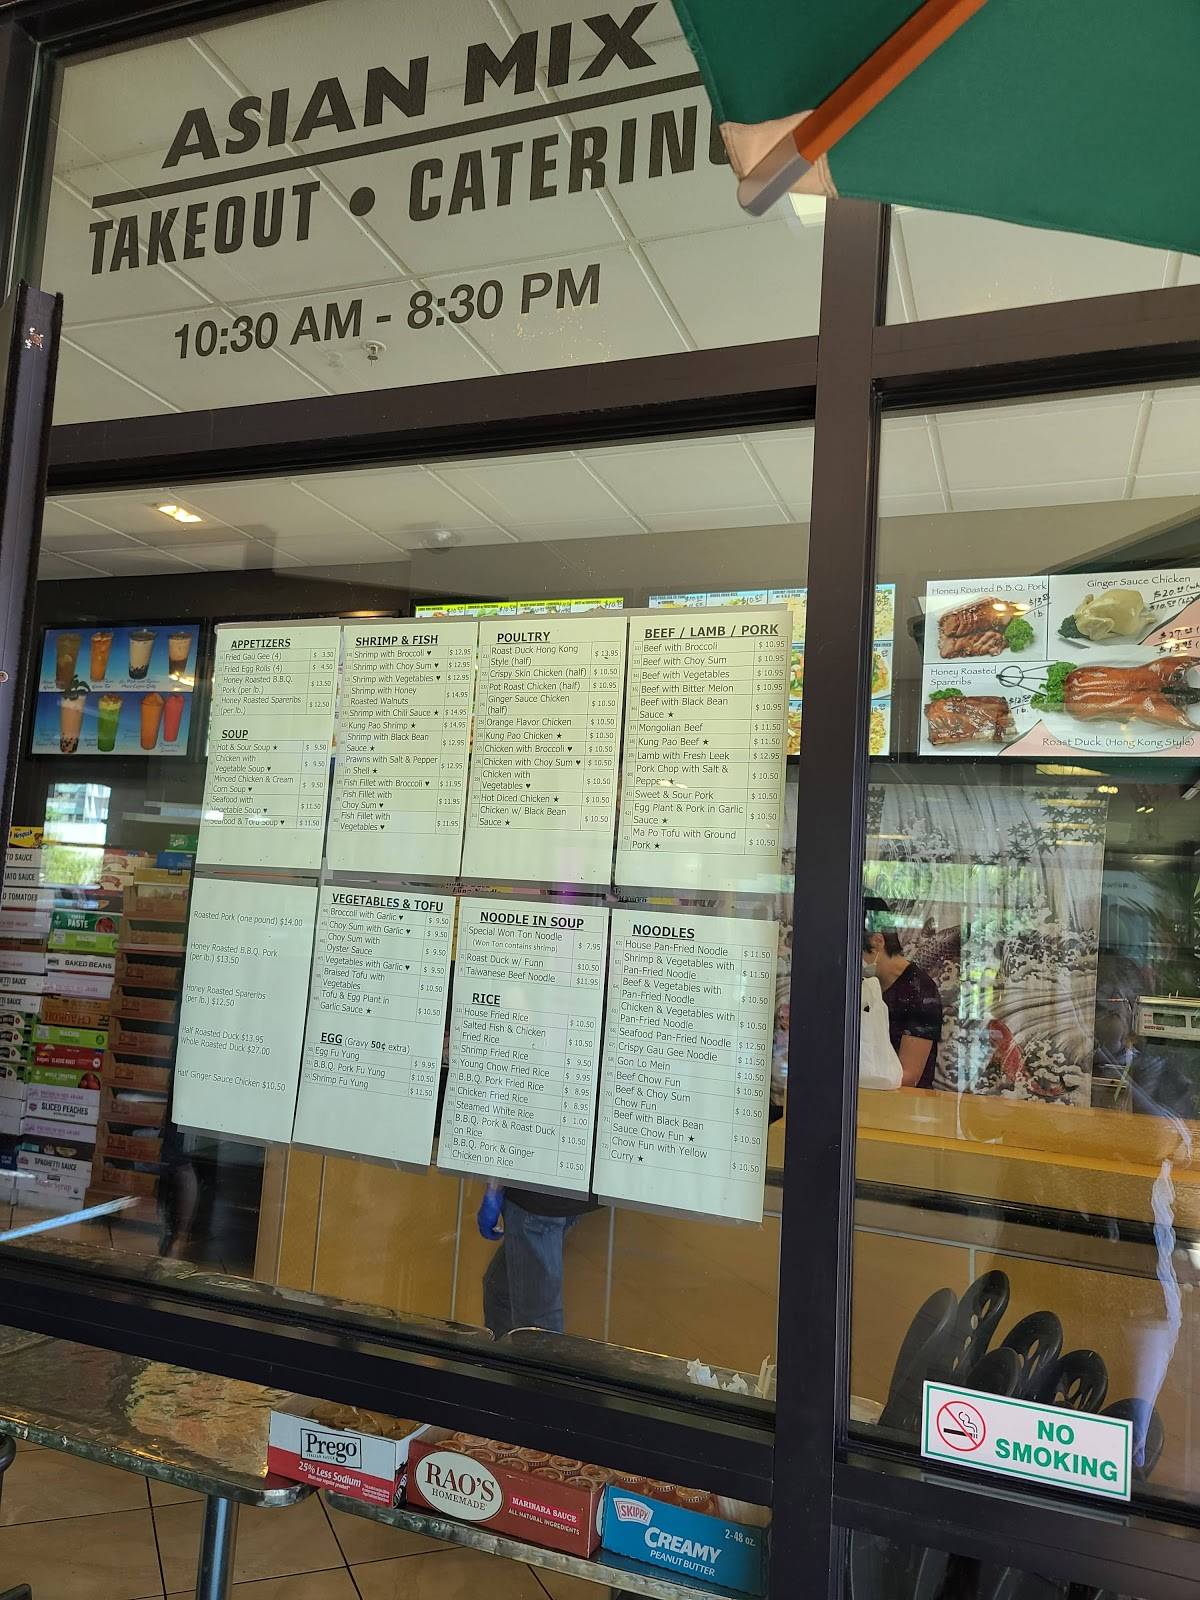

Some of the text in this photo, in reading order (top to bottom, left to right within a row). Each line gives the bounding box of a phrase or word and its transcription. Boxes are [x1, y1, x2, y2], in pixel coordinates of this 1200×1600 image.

[161, 2, 657, 169] ASIAN MIX
[88, 181, 320, 274] TAKEOUT
[174, 311, 278, 360] 10:30
[290, 299, 363, 346] AM
[407, 280, 504, 331] 8:30
[520, 264, 600, 316] PM
[932, 587, 958, 596] Honey
[960, 584, 993, 593] Roasted
[1028, 580, 1047, 591] Pork
[1087, 574, 1191, 589] Ginger Sauce Chicken
[497, 632, 550, 643] POULTRY
[645, 624, 779, 639] BEEF / LAMB / PORK
[231, 639, 291, 649] APPETIZERS
[355, 635, 438, 647] SHRIMP & FISH
[491, 645, 578, 654] Roast Duck Hong Kong
[490, 668, 587, 678] Crispy Skin Chicken (half)
[642, 670, 730, 680] Beef with Vegetables
[961, 666, 996, 674] Roasted
[353, 675, 377, 683] Shrimp
[396, 675, 433, 683] Vegetables
[930, 677, 971, 689] Spareribs
[349, 721, 365, 729] Kung
[384, 722, 408, 730] Shrimp
[639, 723, 703, 733] Mongolian Beef
[222, 730, 248, 739] SOUP
[254, 744, 270, 752] Soup
[1042, 737, 1194, 749] Roast Duck (Hong Kong Style)
[638, 751, 729, 760] Lamb with Fresh Leek
[332, 894, 443, 912] VEGETABLES & TOFU
[68, 919, 88, 928] PASTE
[194, 911, 219, 920] Roasted
[221, 913, 235, 921] Pork
[238, 914, 251, 923] (one
[254, 915, 278, 925] pound)
[480, 912, 584, 929] NOODLE IN SOUP
[330, 921, 403, 935] Choy Sum with Garlic
[469, 926, 562, 941] Special Won Ton Noodle
[633, 925, 695, 938] NOODLES
[625, 940, 728, 956] House Pan-Fried Noodle
[325, 956, 403, 971] Vegetables with Garlic
[472, 993, 500, 1004] RICE
[464, 1008, 528, 1021] House Fried Rice
[321, 1032, 410, 1054] EGG (Gravy 50¢ extra)
[620, 1028, 731, 1048] Seafood Pan-Fried Noodle
[202, 1040, 227, 1050] Roasted
[229, 1043, 245, 1052] Duck
[616, 1071, 681, 1087] Beef Chow Fun
[42, 1102, 88, 1115] SLICED PEACHES
[456, 1101, 534, 1119] Steamed White Rice
[35, 1157, 77, 1170] SPAGHETTI SAUCE
[306, 1433, 357, 1463] Prego
[995, 1419, 1118, 1482] NO SMOKING
[298, 1461, 361, 1487] 25% Less Sodium
[425, 1462, 495, 1502] RAO'S
[432, 1488, 486, 1511] HOMEMADE
[512, 1497, 577, 1522] MARINARA SAUCE
[620, 1504, 649, 1522] SKIPPY
[508, 1508, 580, 1535] ALL NATURAL INGREDIENTS
[725, 1529, 744, 1543] 2-48
[645, 1527, 722, 1564] CREAMY
[650, 1550, 716, 1576] PEANUT BUTTER
